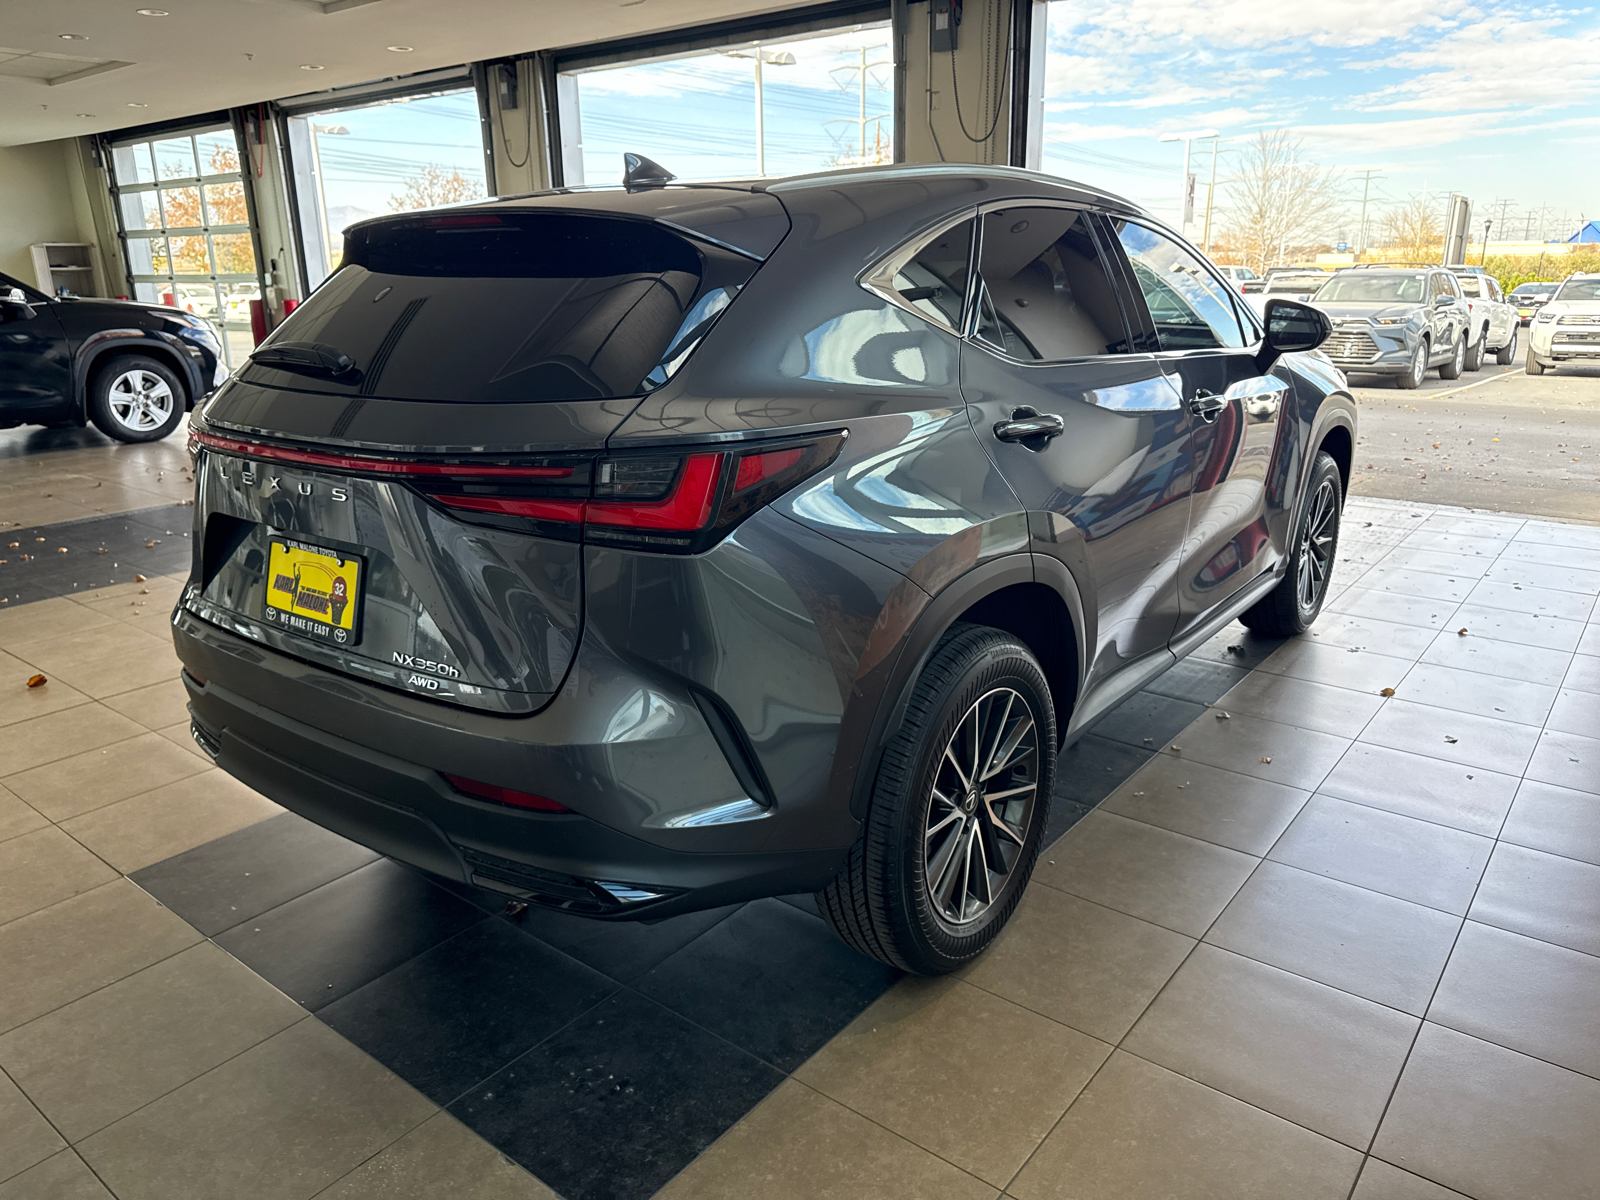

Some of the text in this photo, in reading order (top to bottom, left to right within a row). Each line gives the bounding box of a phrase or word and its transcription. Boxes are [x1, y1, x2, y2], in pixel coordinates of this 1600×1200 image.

[220, 466, 349, 502] LEXUS
[287, 540, 337, 558] KARL MALONE TOYOTA
[273, 573, 295, 594] KARL
[334, 583, 344, 597] 32
[295, 591, 330, 615] MALONE
[280, 613, 330, 637] WE MAKE IT EASY
[392, 651, 460, 678] NX350h
[408, 675, 439, 691] AWD
